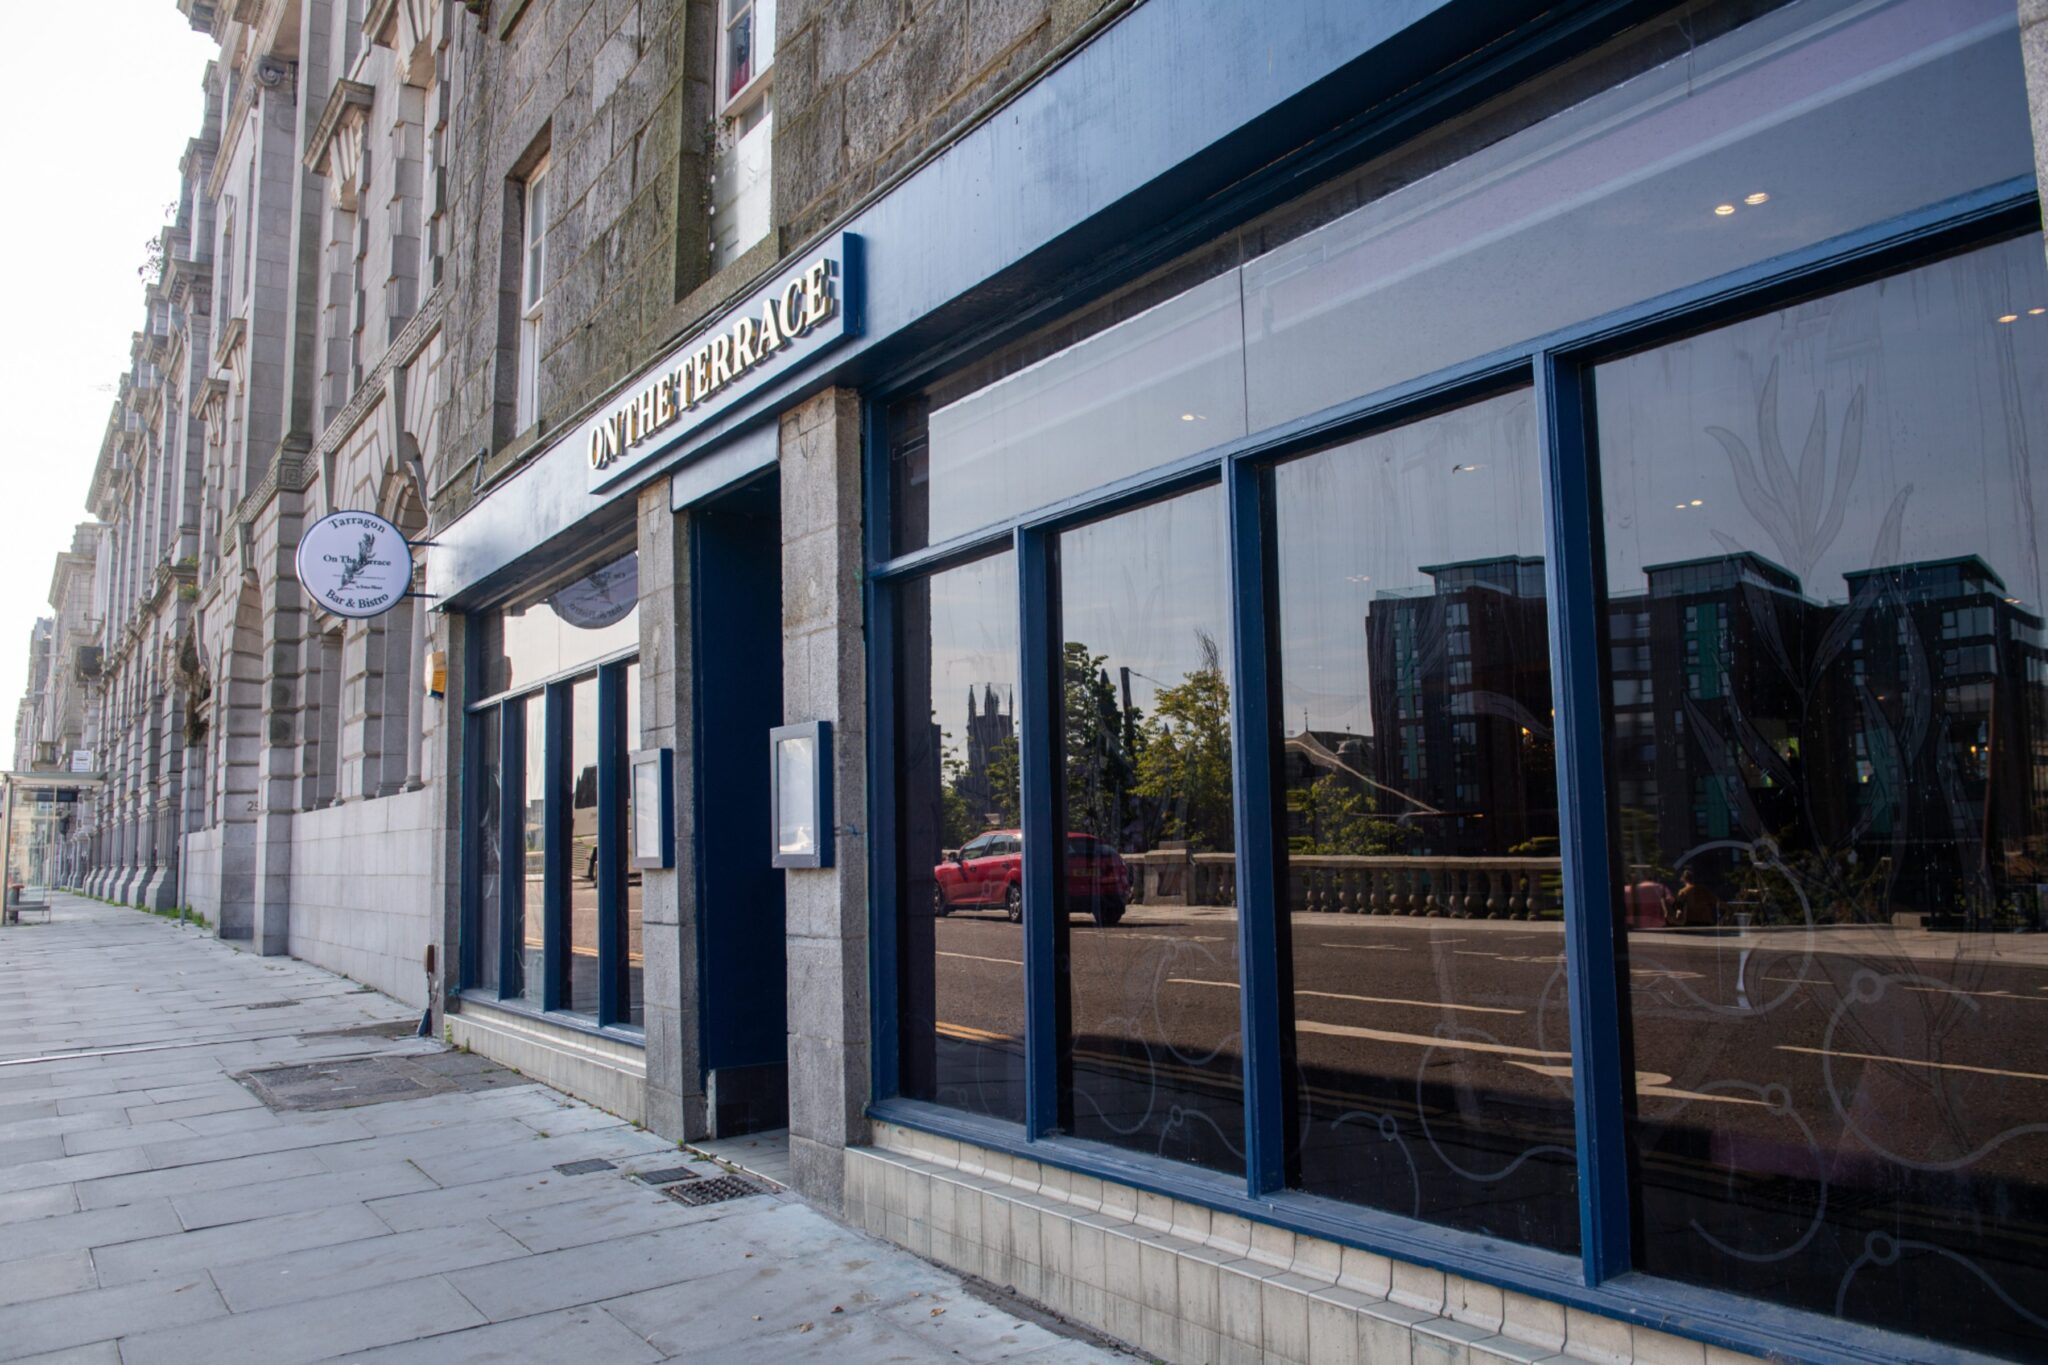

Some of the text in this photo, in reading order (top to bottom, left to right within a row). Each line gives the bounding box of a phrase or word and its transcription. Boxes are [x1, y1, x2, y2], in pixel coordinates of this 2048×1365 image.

[588, 259, 834, 469] ON THE TERRACE
[329, 517, 386, 534] Tarragon
[323, 554, 391, 566] On The rrace
[326, 589, 389, 608] Bar & Bistro
